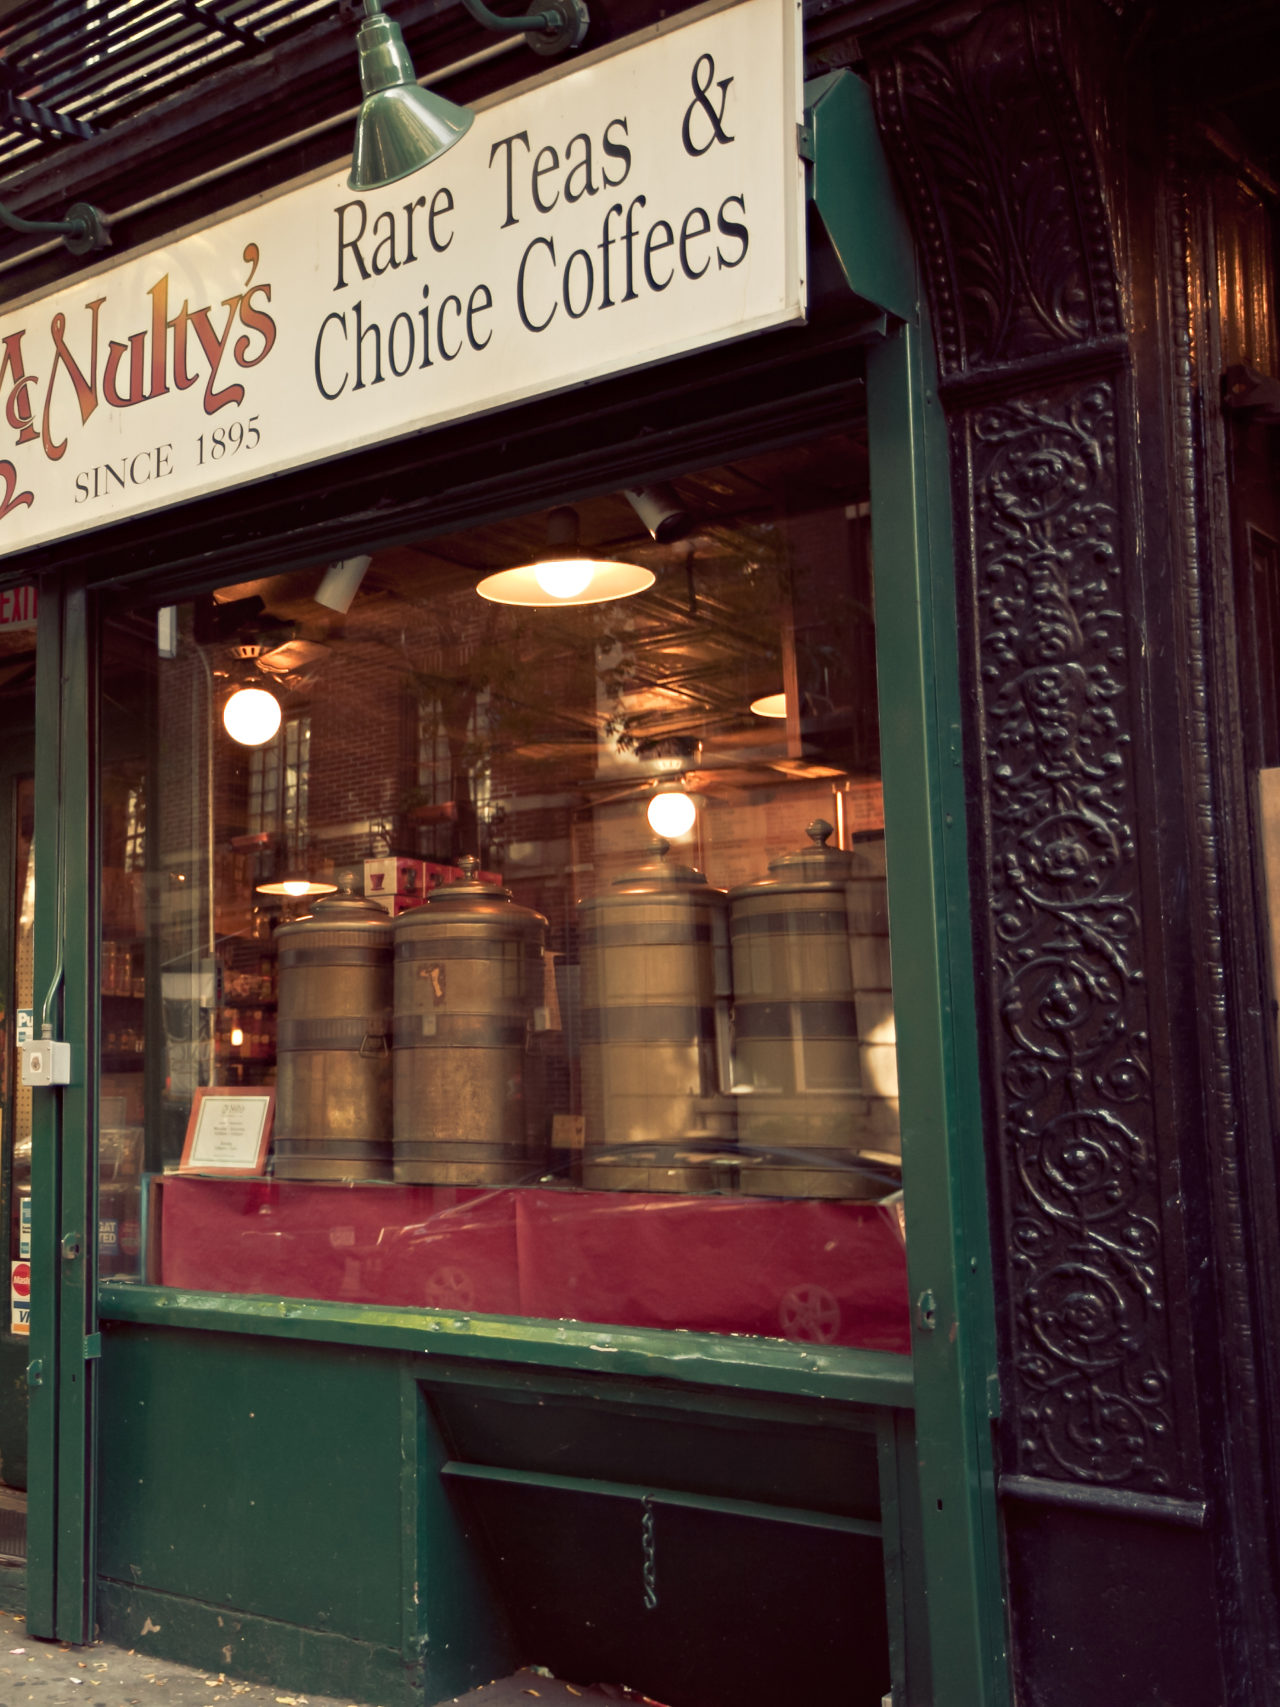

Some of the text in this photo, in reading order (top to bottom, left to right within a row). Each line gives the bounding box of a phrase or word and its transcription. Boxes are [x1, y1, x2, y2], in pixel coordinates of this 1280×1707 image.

[332, 53, 735, 292] Rare Teas &
[314, 193, 750, 401] Choice Coffees
[74, 415, 261, 504] SINCE 1895
[18, 1012, 32, 1027] Pu
[19, 1310, 30, 1324] VI
